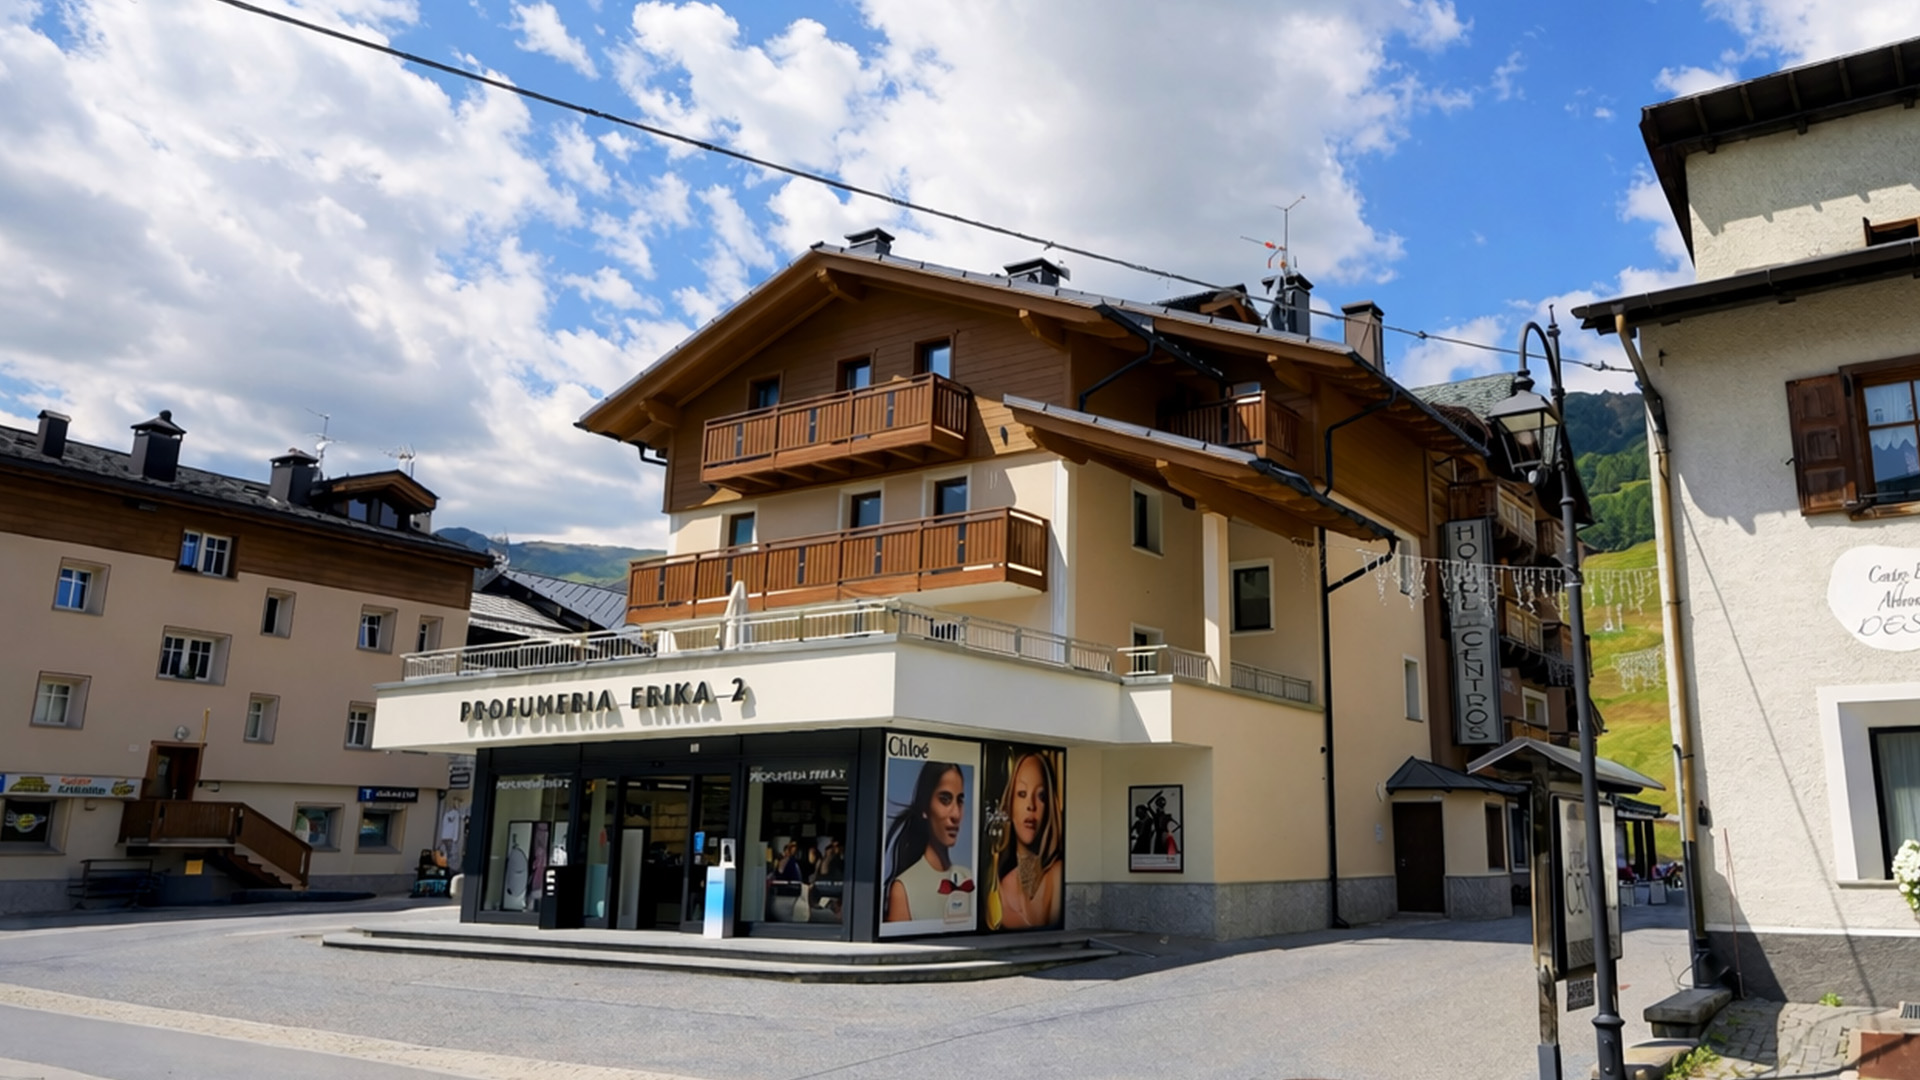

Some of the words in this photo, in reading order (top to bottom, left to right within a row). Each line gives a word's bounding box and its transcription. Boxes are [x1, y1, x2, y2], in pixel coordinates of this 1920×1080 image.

[460, 690, 612, 722] PROFUMERIA
[631, 681, 710, 709] ERIKA
[731, 678, 746, 702] 2
[888, 736, 929, 759] Chloé
